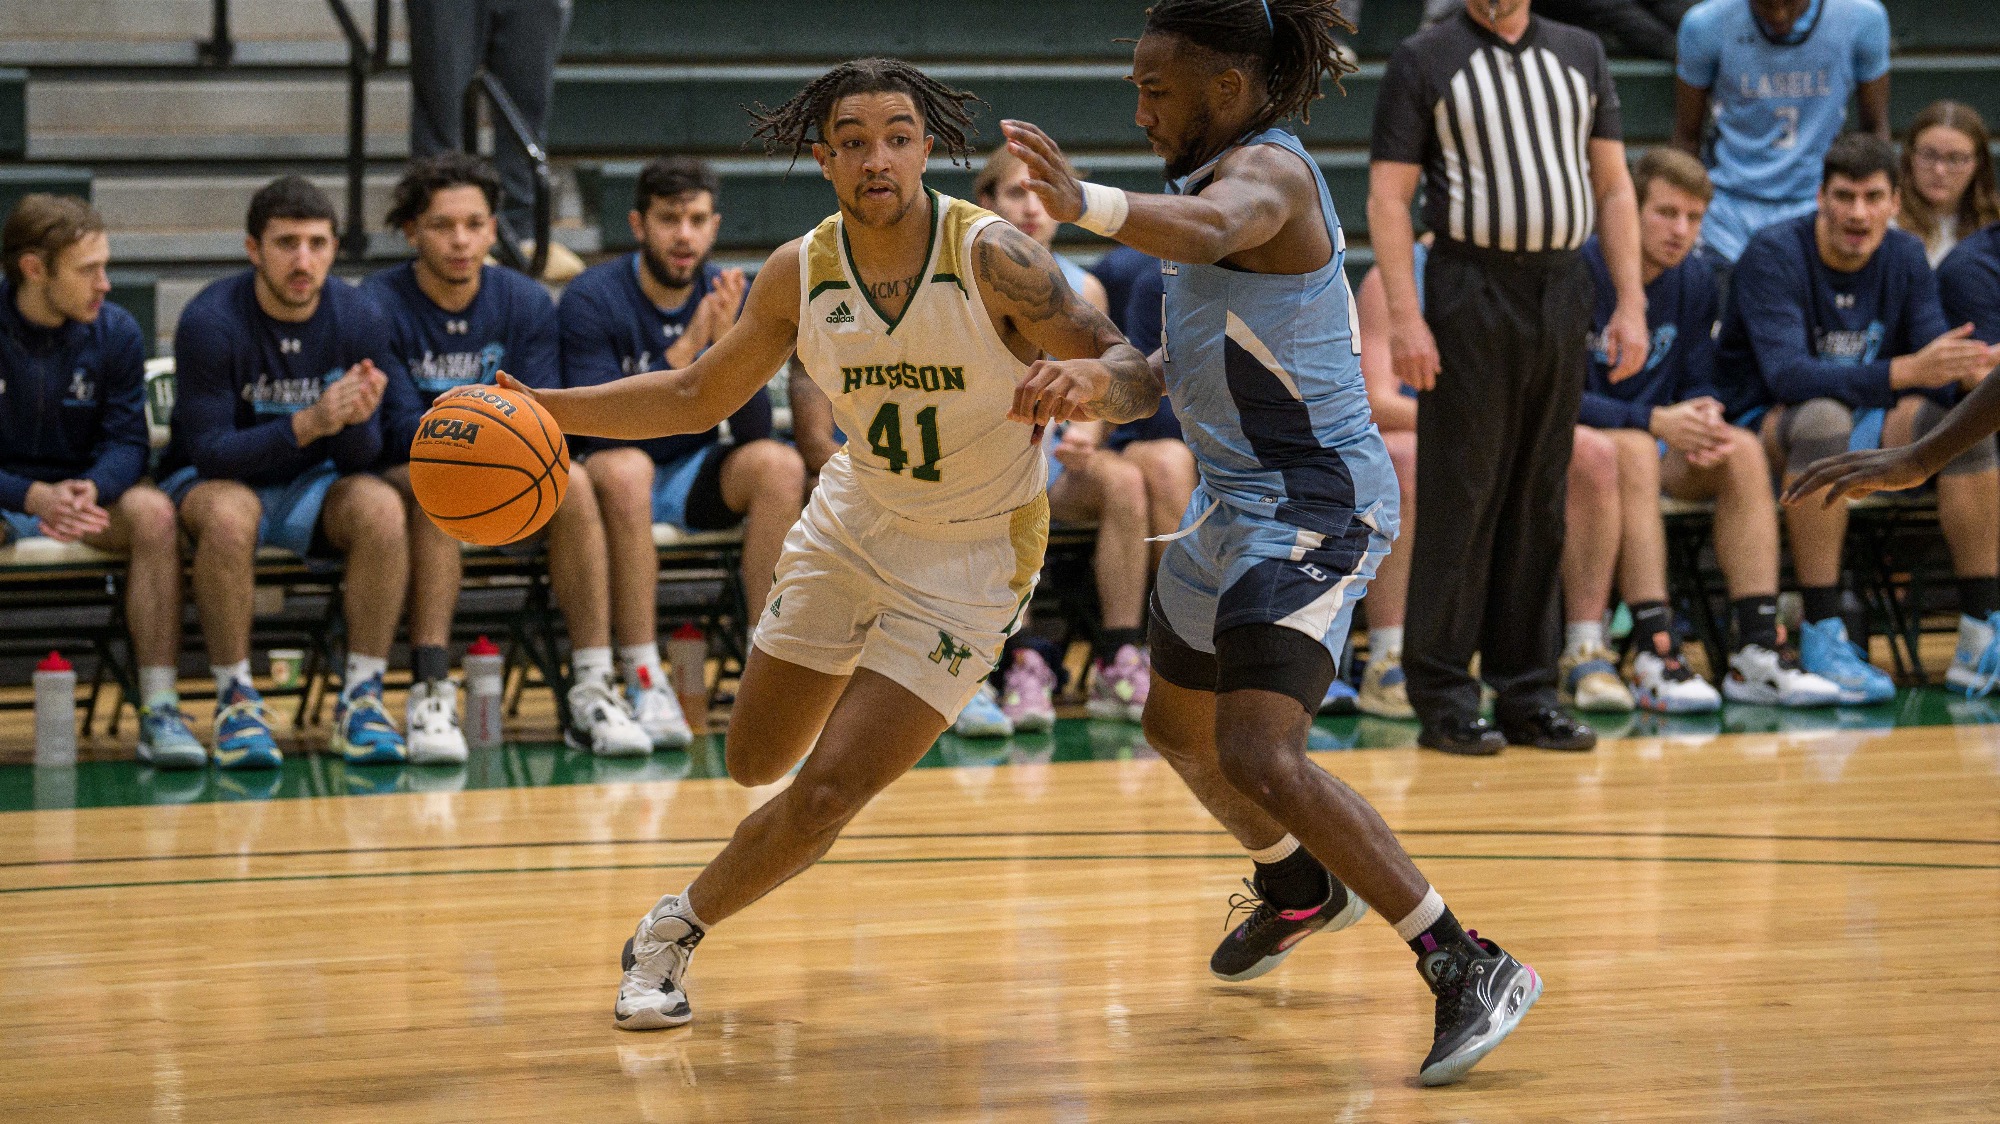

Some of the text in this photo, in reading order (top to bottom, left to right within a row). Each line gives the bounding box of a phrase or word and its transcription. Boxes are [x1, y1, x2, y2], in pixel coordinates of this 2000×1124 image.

[826, 314, 855, 324] adidas
[840, 361, 967, 394] HUSSON
[417, 418, 480, 445] NCAA
[867, 401, 943, 484] 41
